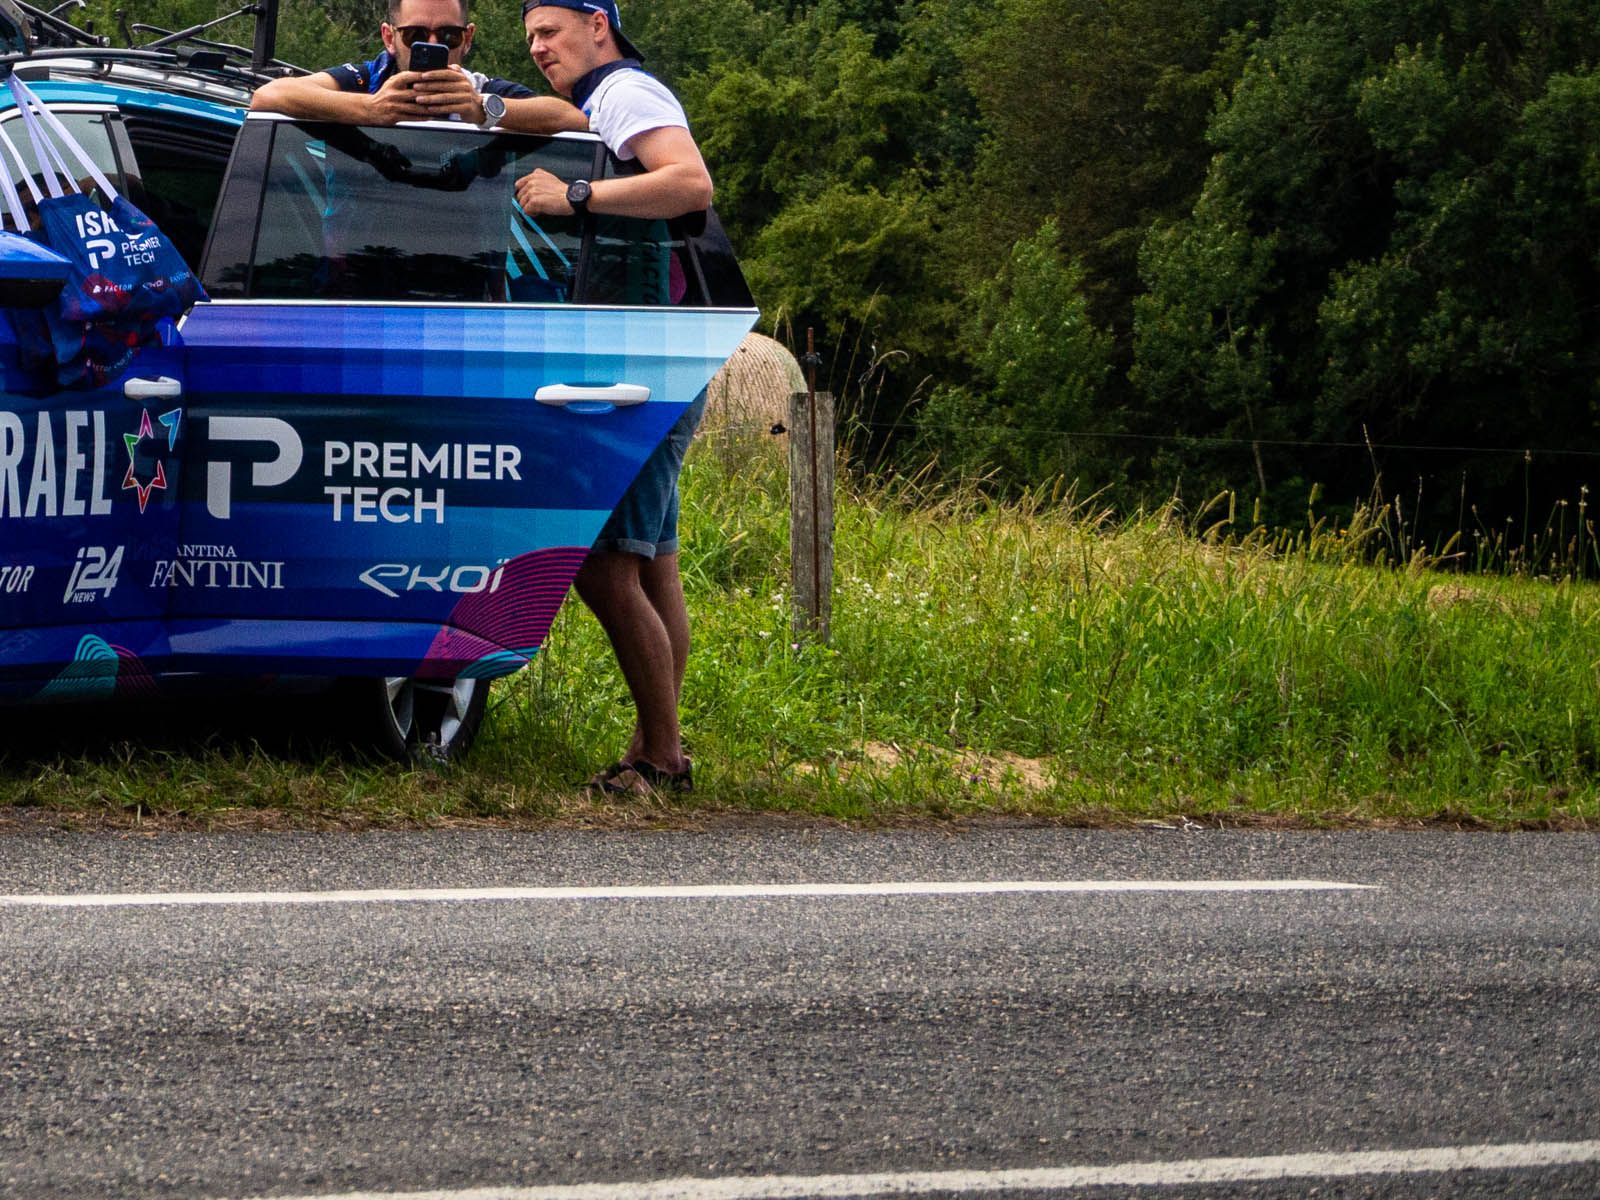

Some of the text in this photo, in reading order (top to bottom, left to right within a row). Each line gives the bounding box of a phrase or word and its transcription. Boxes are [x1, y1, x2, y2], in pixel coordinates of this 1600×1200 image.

[123, 251, 156, 267] TECH
[324, 440, 522, 481] PREMIER
[324, 485, 445, 524] TECH
[176, 544, 237, 557] ANTINA
[63, 545, 125, 604] i24
[149, 560, 285, 589] FANTINI
[72, 591, 97, 603] NEWS
